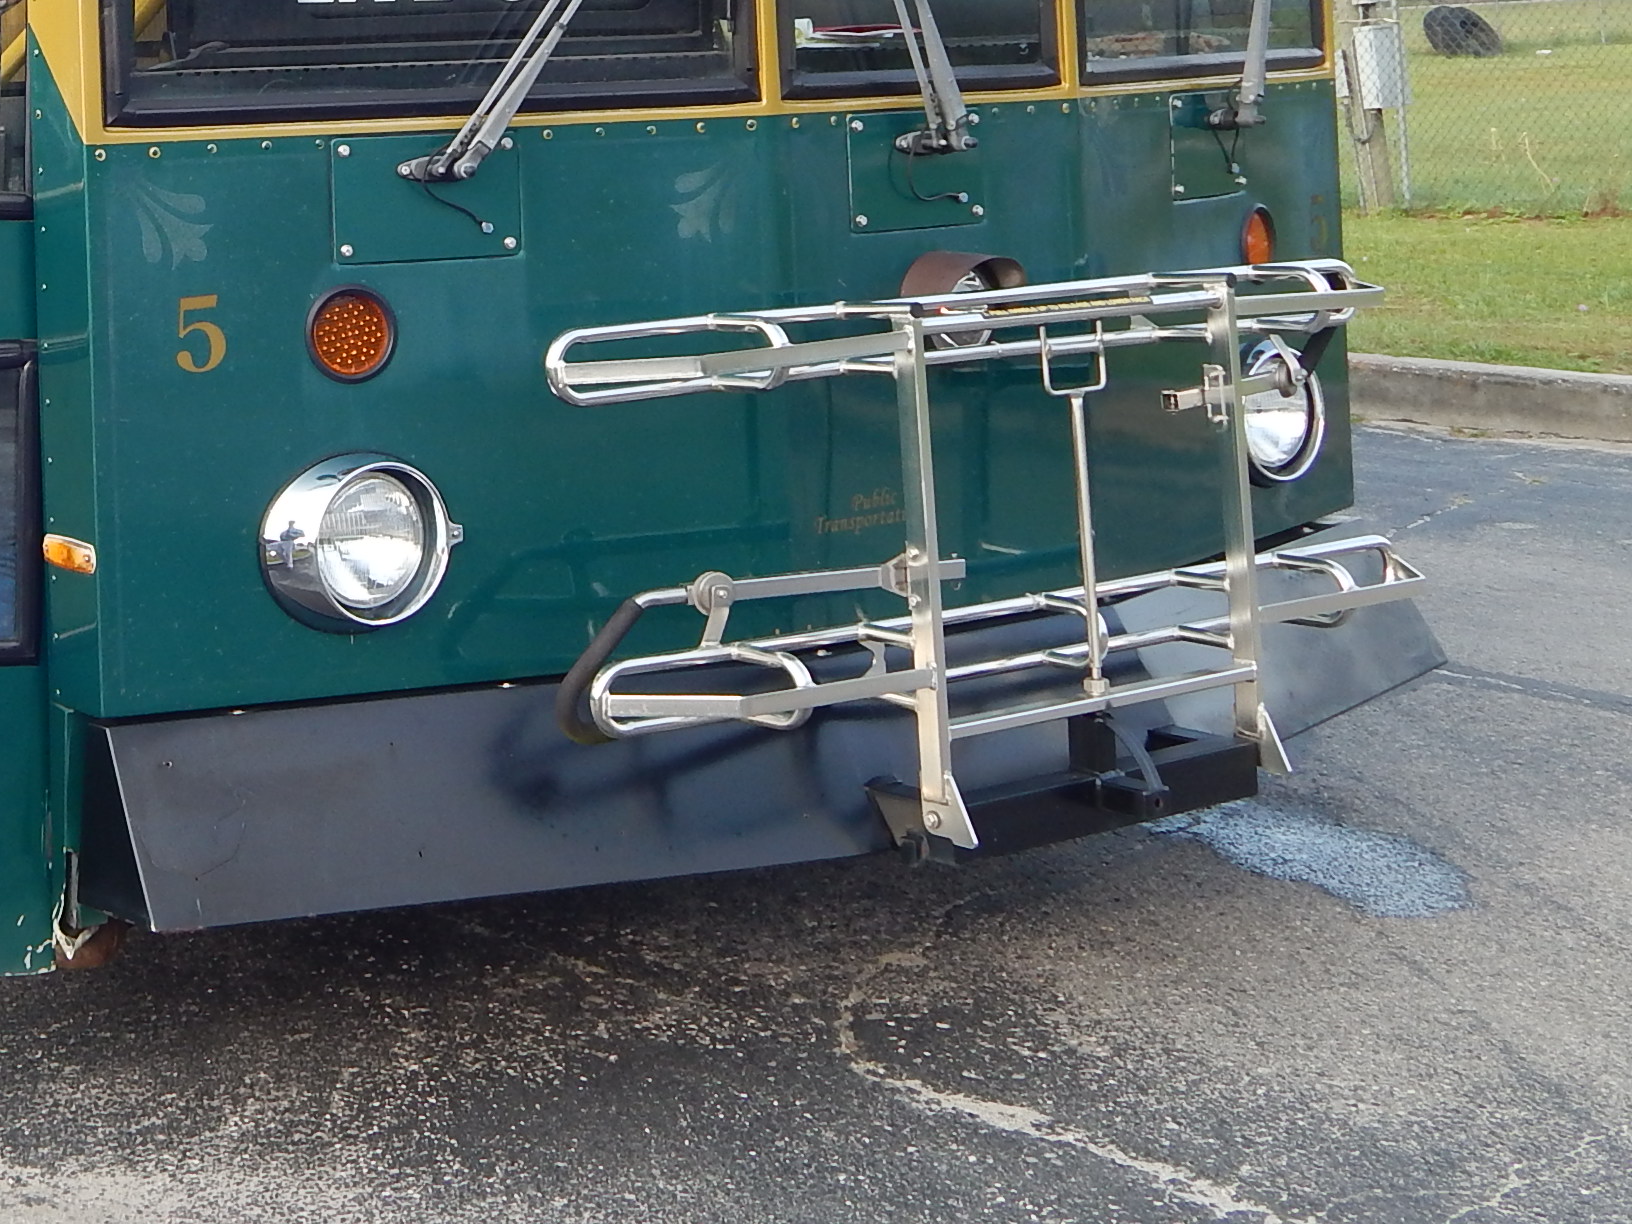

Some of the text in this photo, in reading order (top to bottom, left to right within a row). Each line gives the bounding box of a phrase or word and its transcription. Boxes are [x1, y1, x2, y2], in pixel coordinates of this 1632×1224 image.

[176, 294, 227, 373] 5
[852, 486, 898, 512] Public
[815, 508, 906, 534] Transportati
